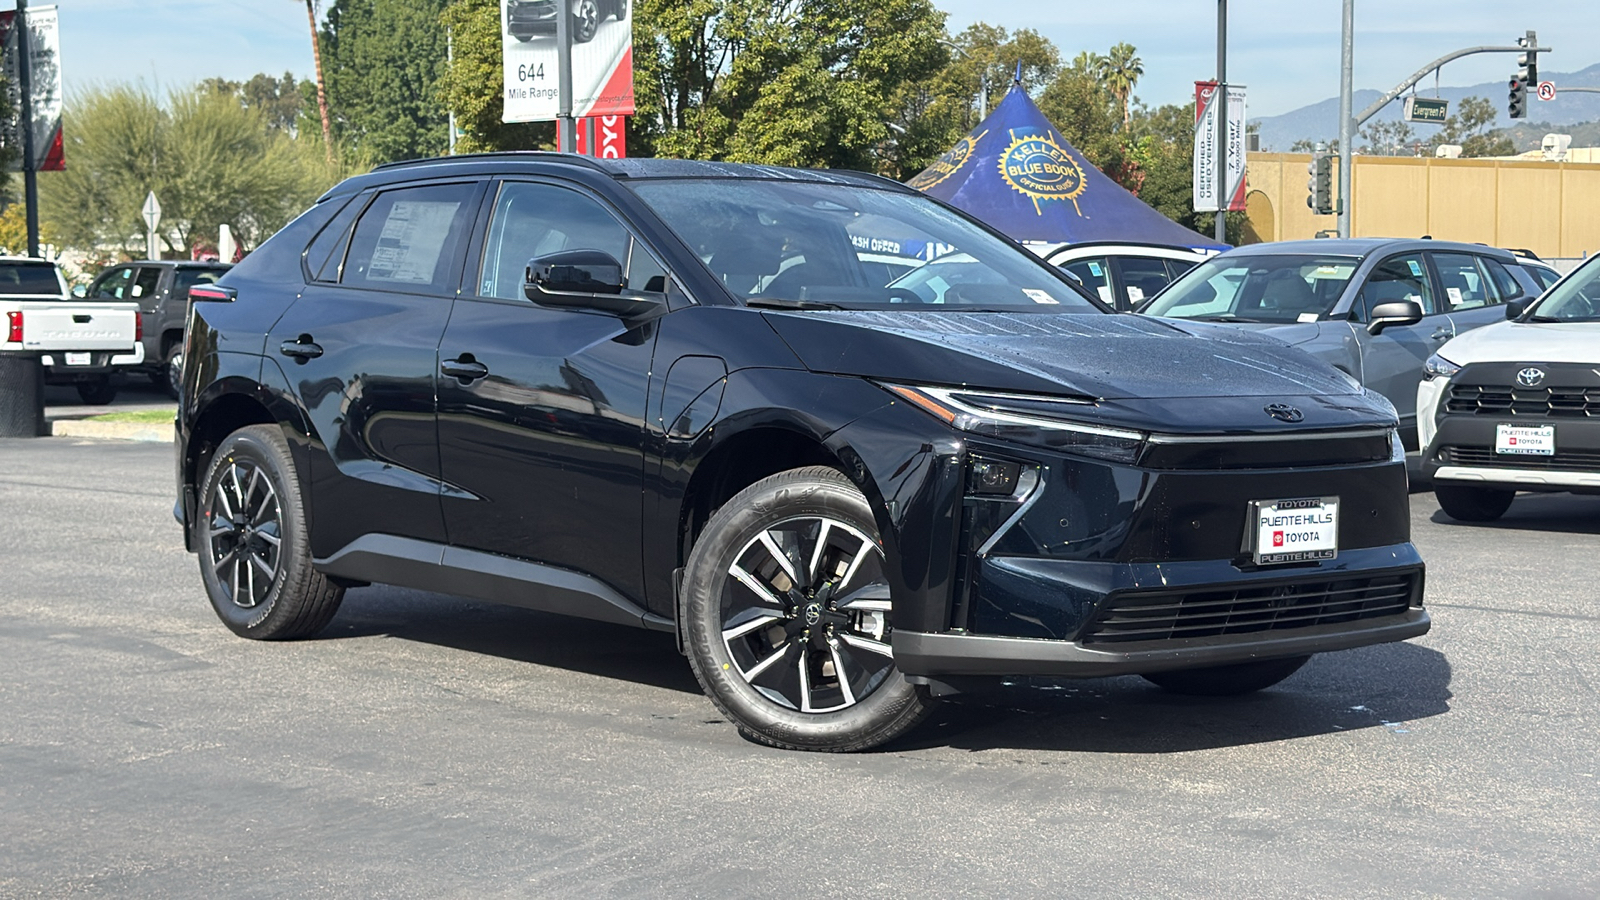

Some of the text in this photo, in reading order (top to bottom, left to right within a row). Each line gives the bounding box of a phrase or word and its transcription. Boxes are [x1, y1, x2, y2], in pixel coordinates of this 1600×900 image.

[518, 63, 545, 82] 644
[508, 88, 558, 100] Mile Range
[1011, 143, 1068, 162] KELLEY
[1008, 163, 1078, 178] BLUE BOOK
[1020, 177, 1057, 191] OFFICIAL
[849, 235, 869, 249] ASH
[1278, 499, 1320, 508] TOYOTA
[1260, 513, 1333, 527] PUENTE HILLS
[1285, 531, 1320, 542] TOYOTA
[1261, 550, 1333, 563] PUENTE HILLS
